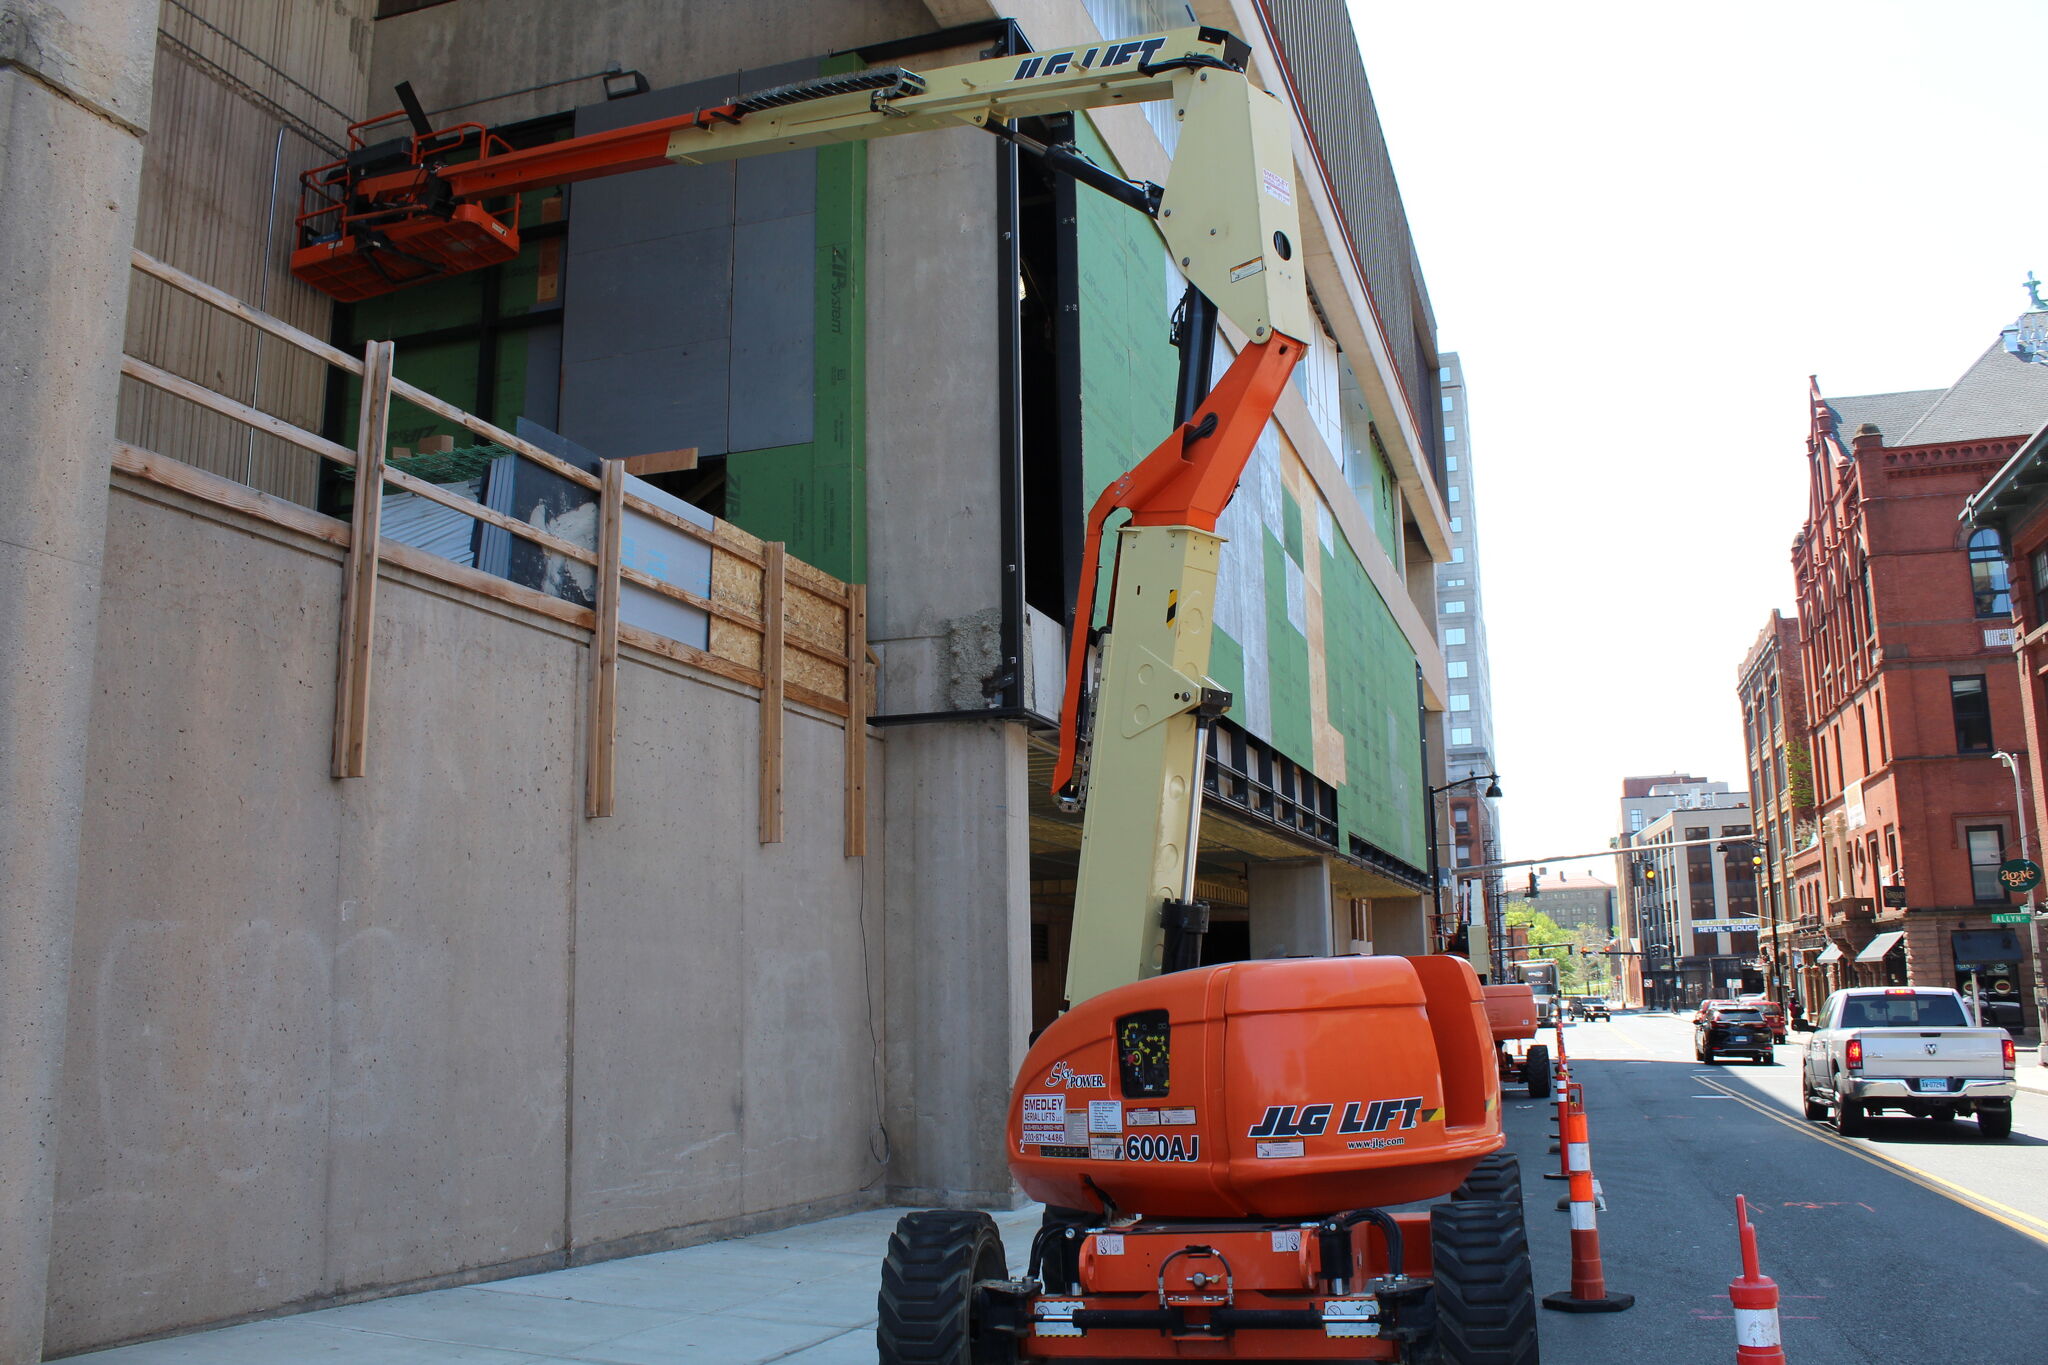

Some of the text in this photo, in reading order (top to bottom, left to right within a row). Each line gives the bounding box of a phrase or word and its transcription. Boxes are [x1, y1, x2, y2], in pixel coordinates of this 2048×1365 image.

[1995, 914, 2022, 923] ALLYN
[1069, 1073, 1105, 1088] POWER
[1024, 1098, 1064, 1111] SMEDLEY
[1024, 1112, 1041, 1122] AERIAL
[1041, 1111, 1056, 1122] LIFTS
[1248, 1096, 1423, 1137] JLG LIFT
[1126, 1134, 1199, 1162] 600AJ
[1347, 1137, 1405, 1150] www.jlg.com
